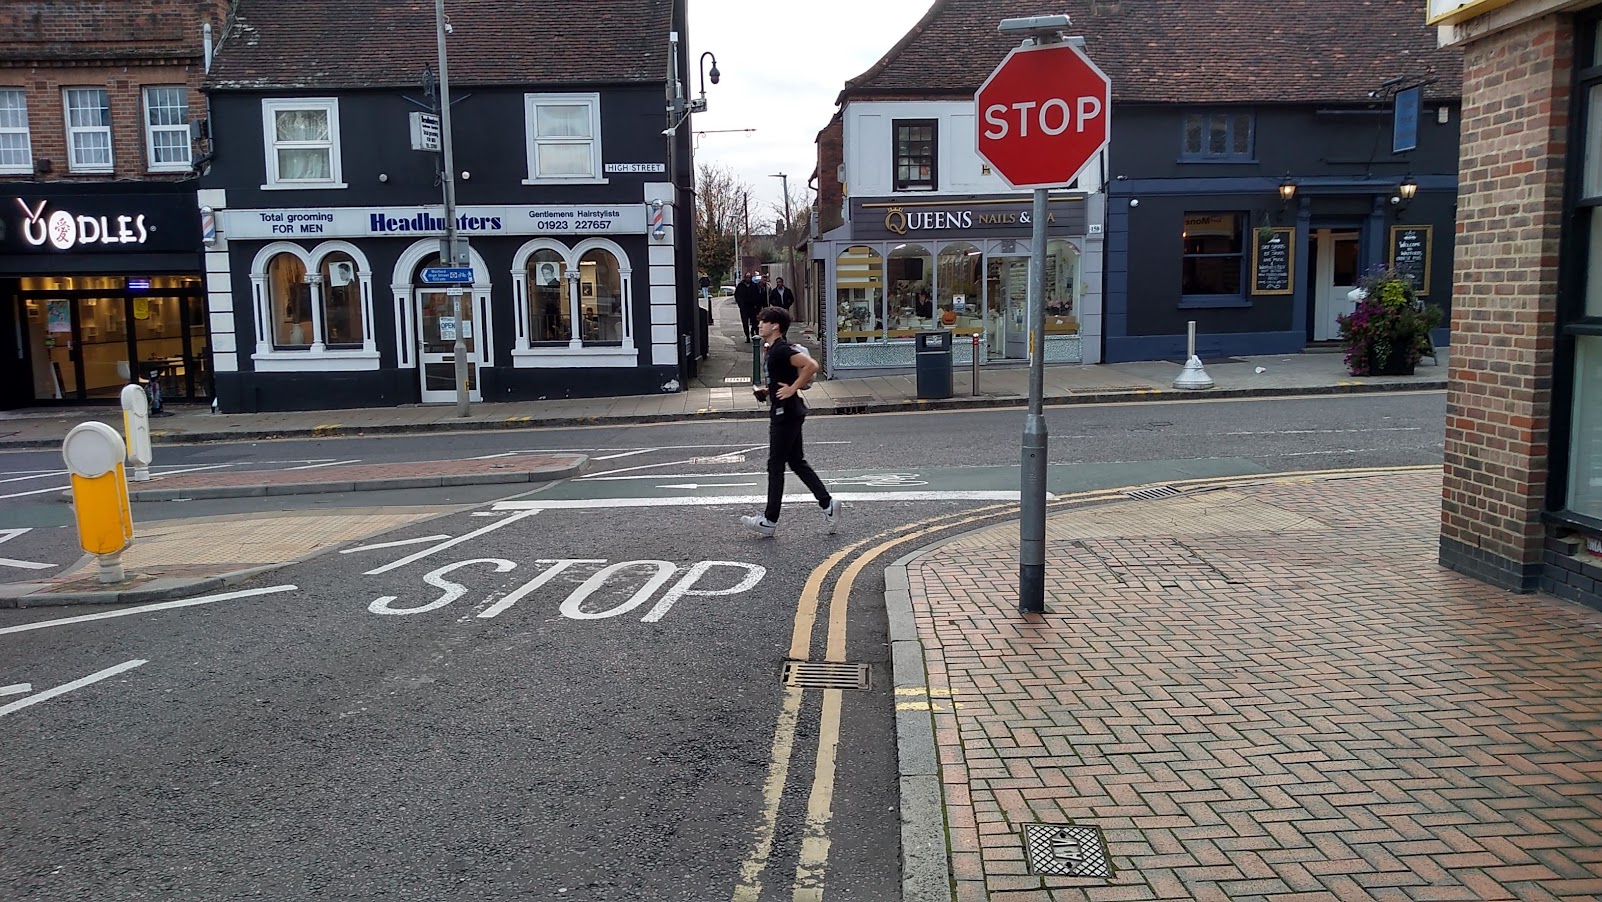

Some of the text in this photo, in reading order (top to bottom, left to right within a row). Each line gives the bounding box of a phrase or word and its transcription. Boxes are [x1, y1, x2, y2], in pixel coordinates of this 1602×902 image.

[984, 96, 1102, 140] STOP
[259, 213, 333, 223] Total grooming
[528, 209, 620, 218] Gentlemens Hairstylists
[537, 220, 612, 230] 01923 227657
[885, 208, 1031, 235] QUEENS NAILS &
[272, 224, 323, 233] FOR MEN
[367, 558, 767, 623] STOP
